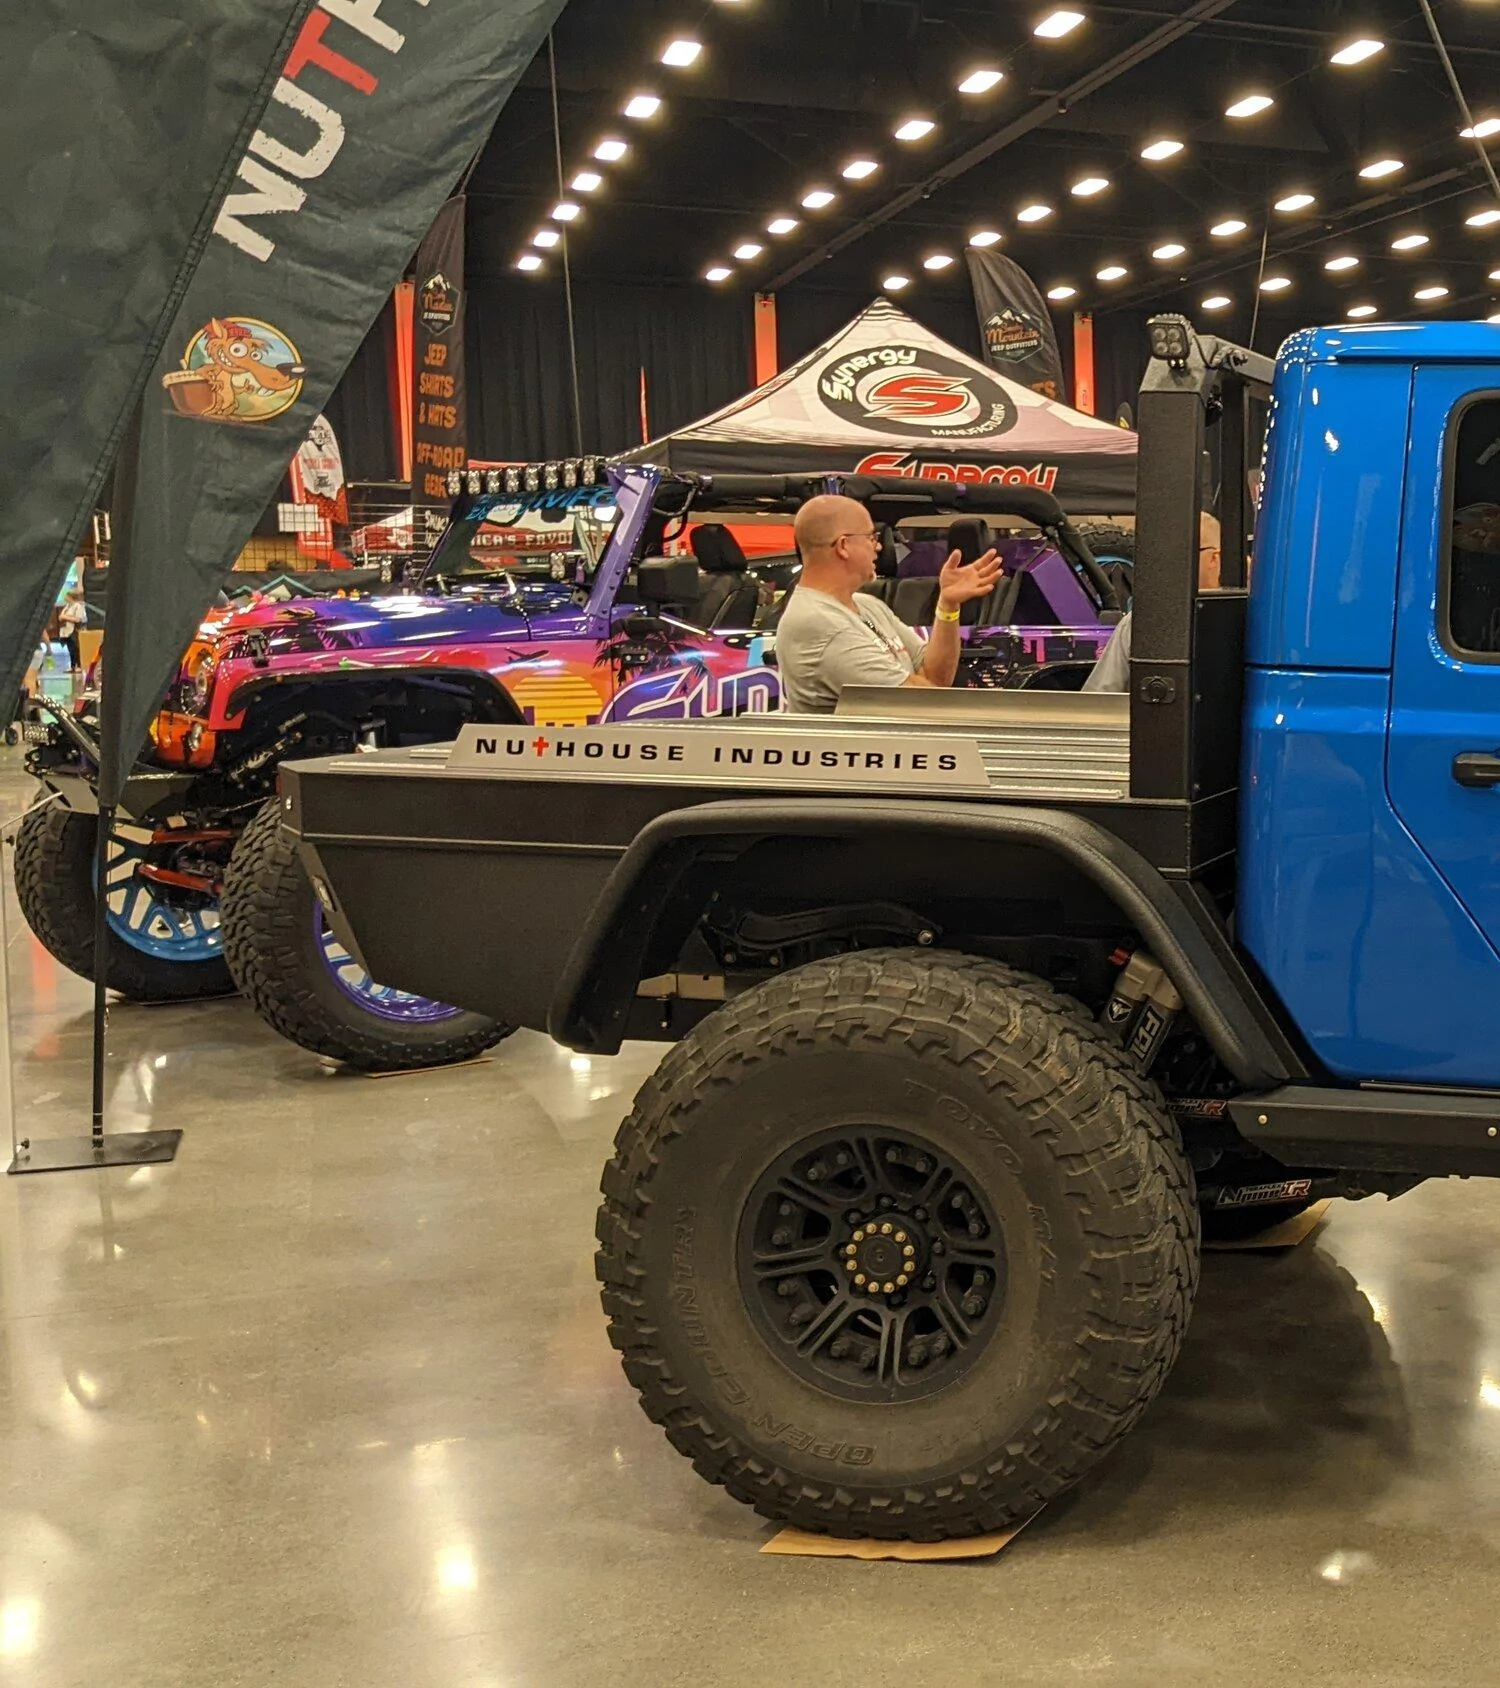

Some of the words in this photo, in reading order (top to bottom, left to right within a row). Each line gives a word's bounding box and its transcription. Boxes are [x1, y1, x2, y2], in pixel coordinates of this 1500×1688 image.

[424, 343, 448, 367] JEEP
[419, 371, 454, 398] SHIRTS
[822, 349, 917, 402] Synergy
[428, 404, 457, 429] HATS
[931, 403, 1006, 436] MANUFACTURING
[714, 746, 958, 771] INDUSTRIES
